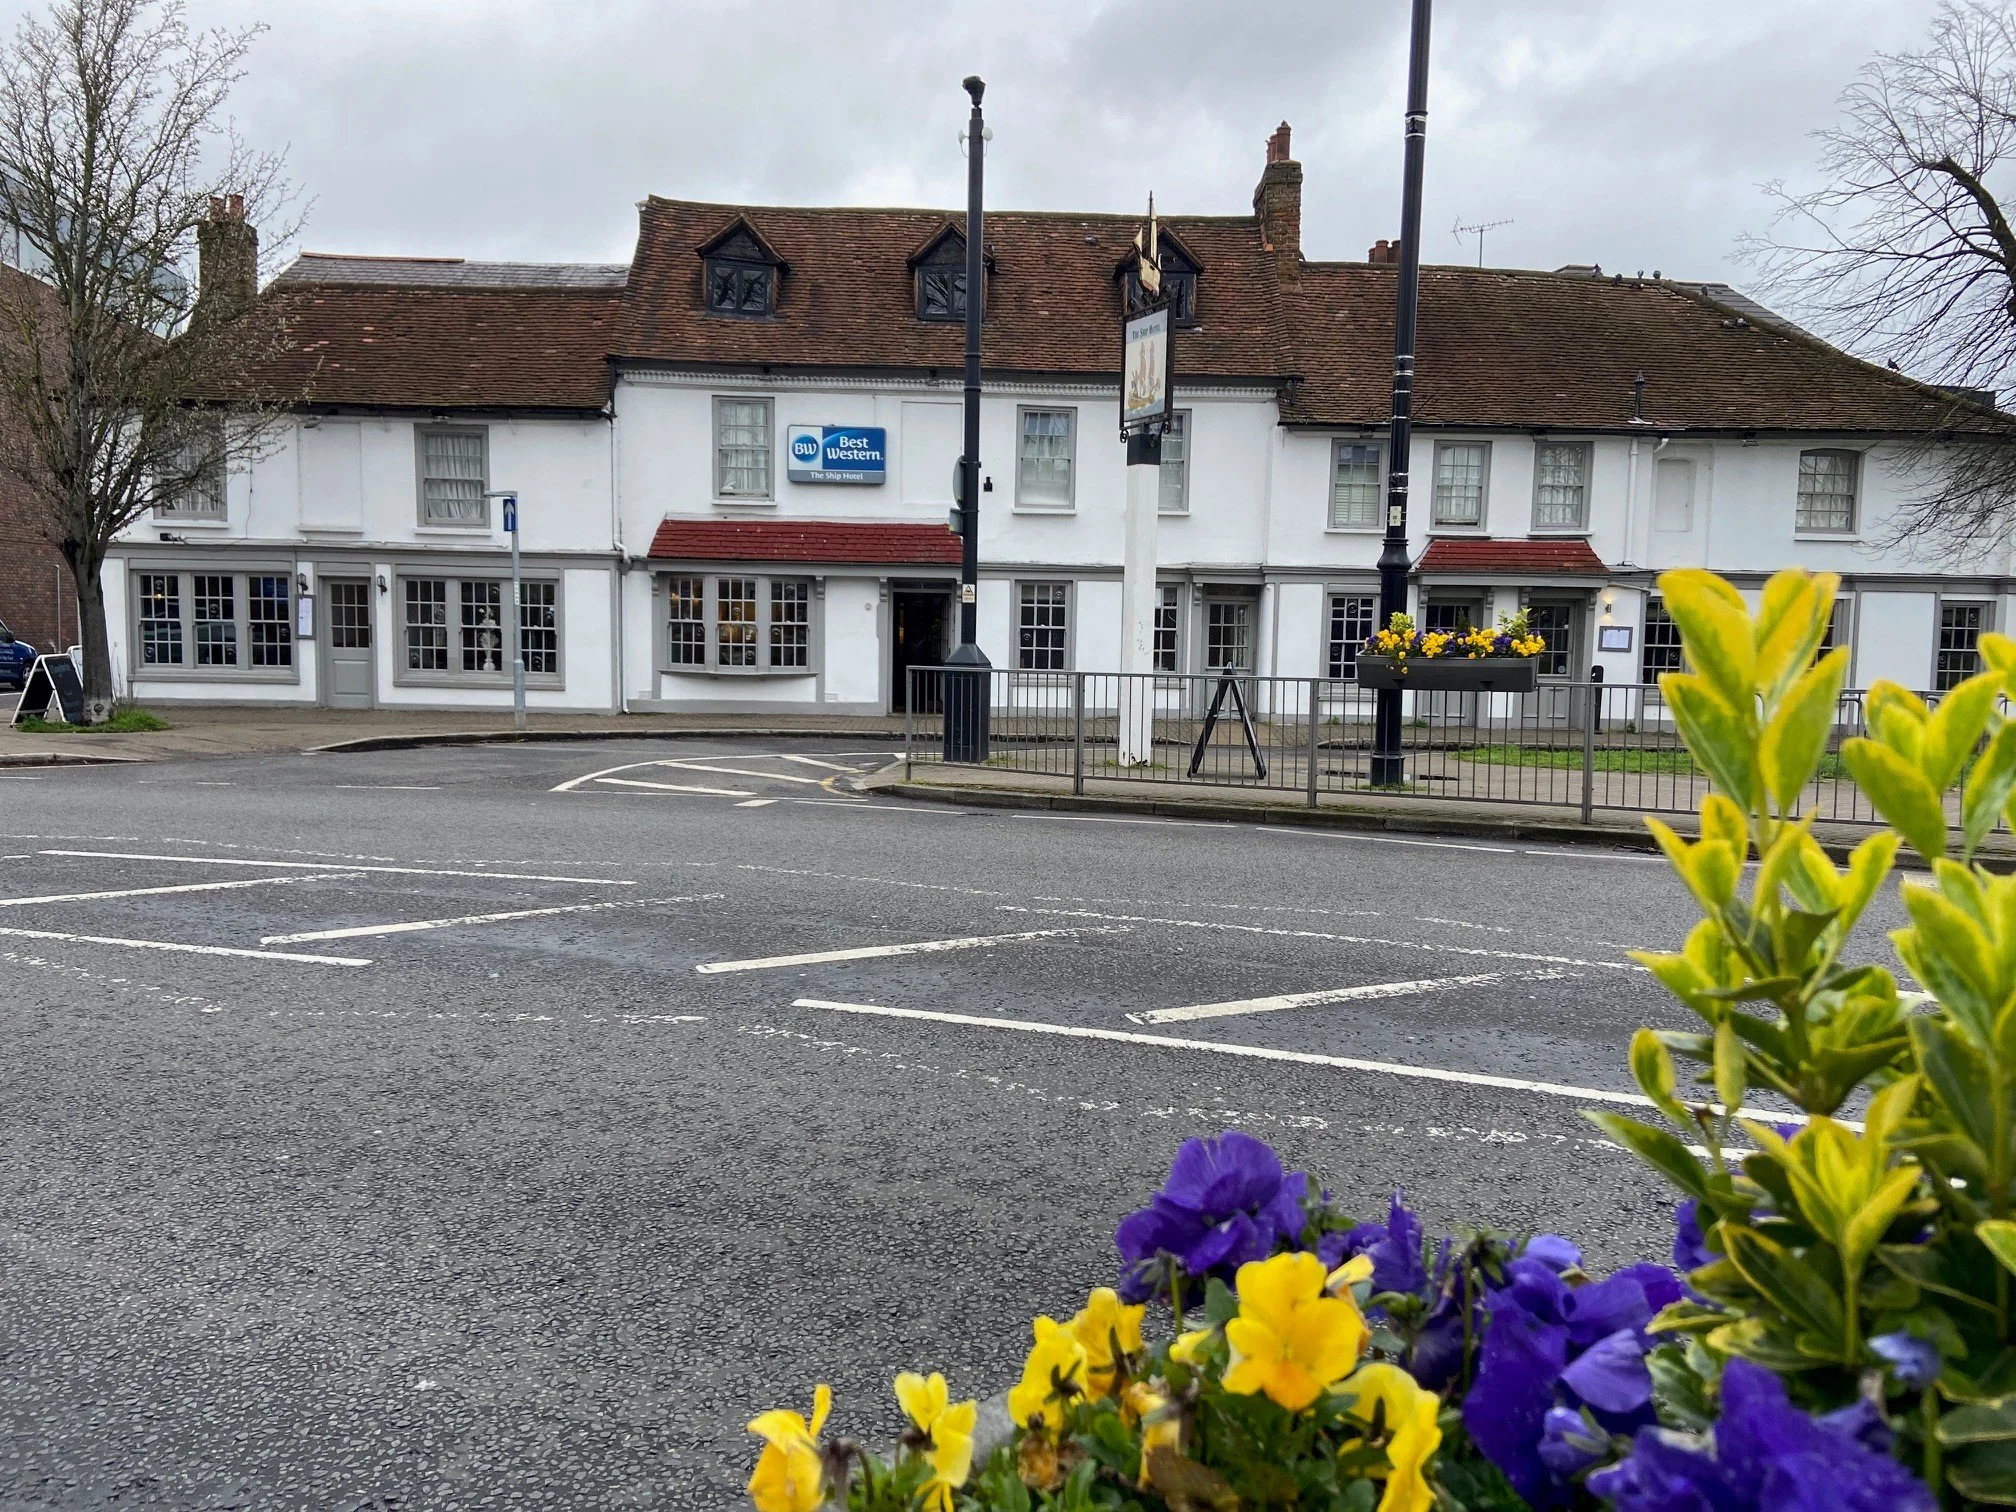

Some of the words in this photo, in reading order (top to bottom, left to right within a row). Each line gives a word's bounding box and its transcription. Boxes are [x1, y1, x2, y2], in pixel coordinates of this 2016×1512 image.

[840, 436, 868, 448] Best
[794, 443, 817, 455] BW
[810, 471, 824, 479] The
[825, 472, 842, 481] Ship
[843, 472, 863, 480] Hotel
